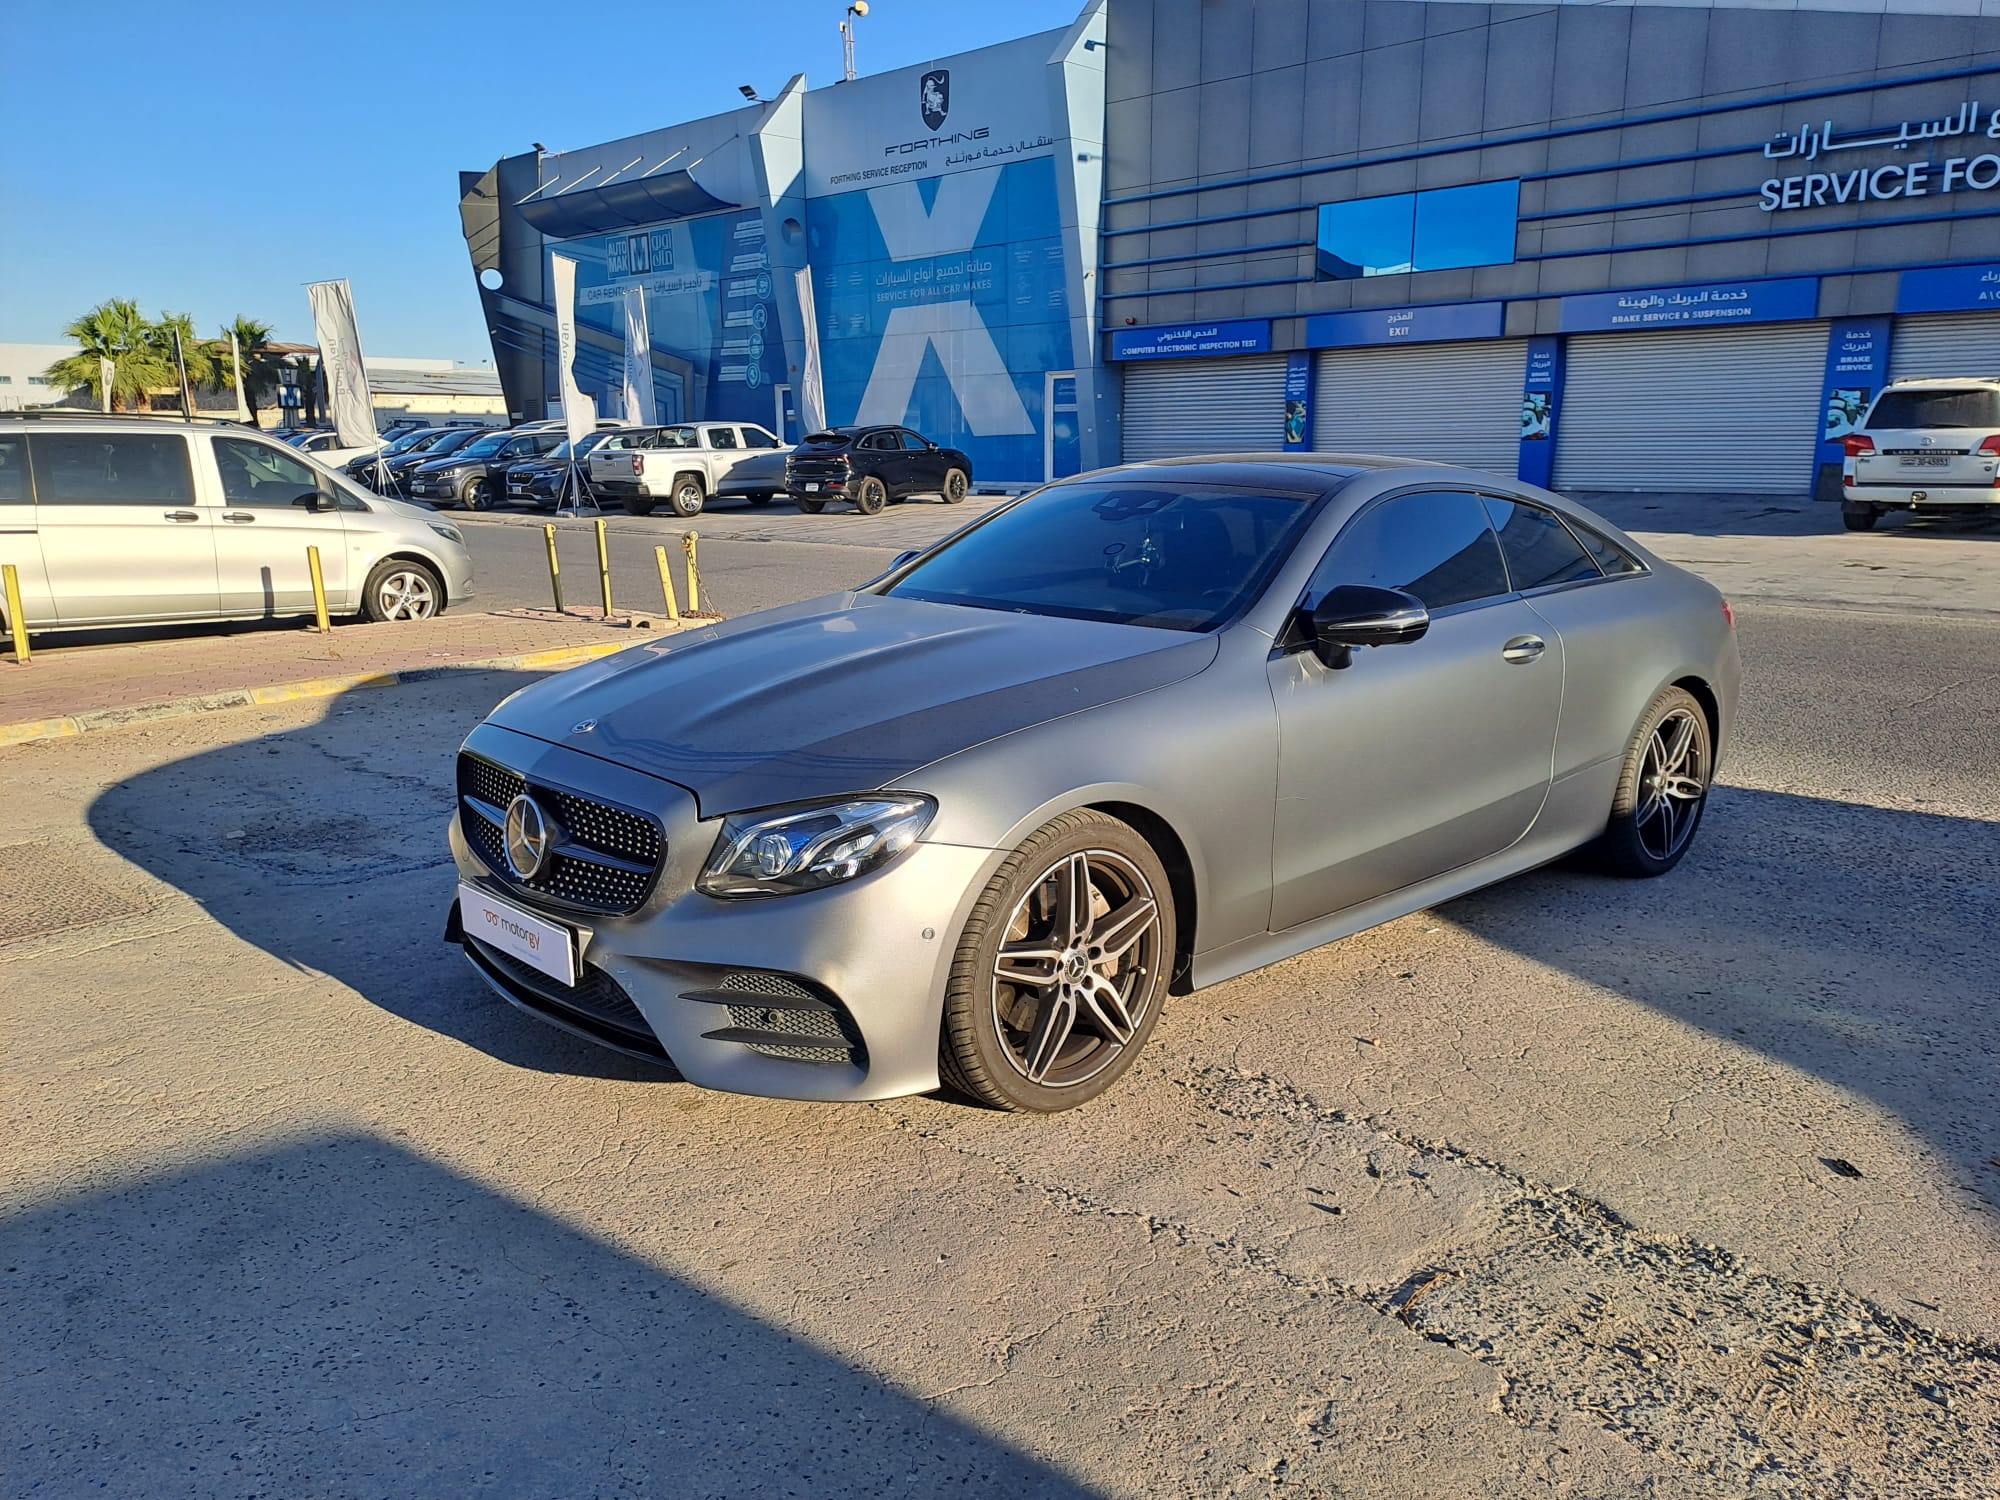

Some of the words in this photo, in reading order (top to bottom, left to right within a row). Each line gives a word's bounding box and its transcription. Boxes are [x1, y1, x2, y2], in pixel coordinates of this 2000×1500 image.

[1763, 101, 1979, 161] السيارات
[884, 127, 990, 157] FORTHING
[983, 143, 1014, 157] خدمة
[1016, 135, 1053, 153] ستقبال
[830, 172, 862, 185] FORTHING
[862, 167, 889, 180] SERVICE
[890, 160, 928, 175] RECEPTION
[1758, 161, 1930, 212] SERVICE
[608, 241, 627, 256] AUTO
[608, 256, 628, 273] MAK
[936, 261, 964, 280] لجميع
[967, 259, 992, 275] صيانة
[875, 268, 911, 287] السيارات
[875, 291, 907, 303] SERVICE
[910, 288, 925, 298] FOR
[927, 287, 940, 297] ALL
[943, 284, 960, 294] CAR
[963, 279, 992, 291] MAKES
[1667, 291, 1709, 306] البريك
[1711, 289, 1748, 301] خدمة
[1387, 311, 1414, 324] المخرج
[1611, 315, 1641, 323] BRAKE
[1643, 312, 1681, 322] SERVICE
[1692, 307, 1752, 318] SUSPENSION
[1192, 327, 1218, 339] الفحص
[1389, 326, 1410, 337] EXIT
[1846, 330, 1872, 339] خدمة
[1122, 346, 1156, 355] COMPUTER
[1157, 344, 1197, 353] ELECTRONIC
[1199, 340, 1240, 350] INSPECTION
[1242, 339, 1257, 348] TEST
[1841, 342, 1873, 351] البريك
[500, 917, 540, 951] motorgy
